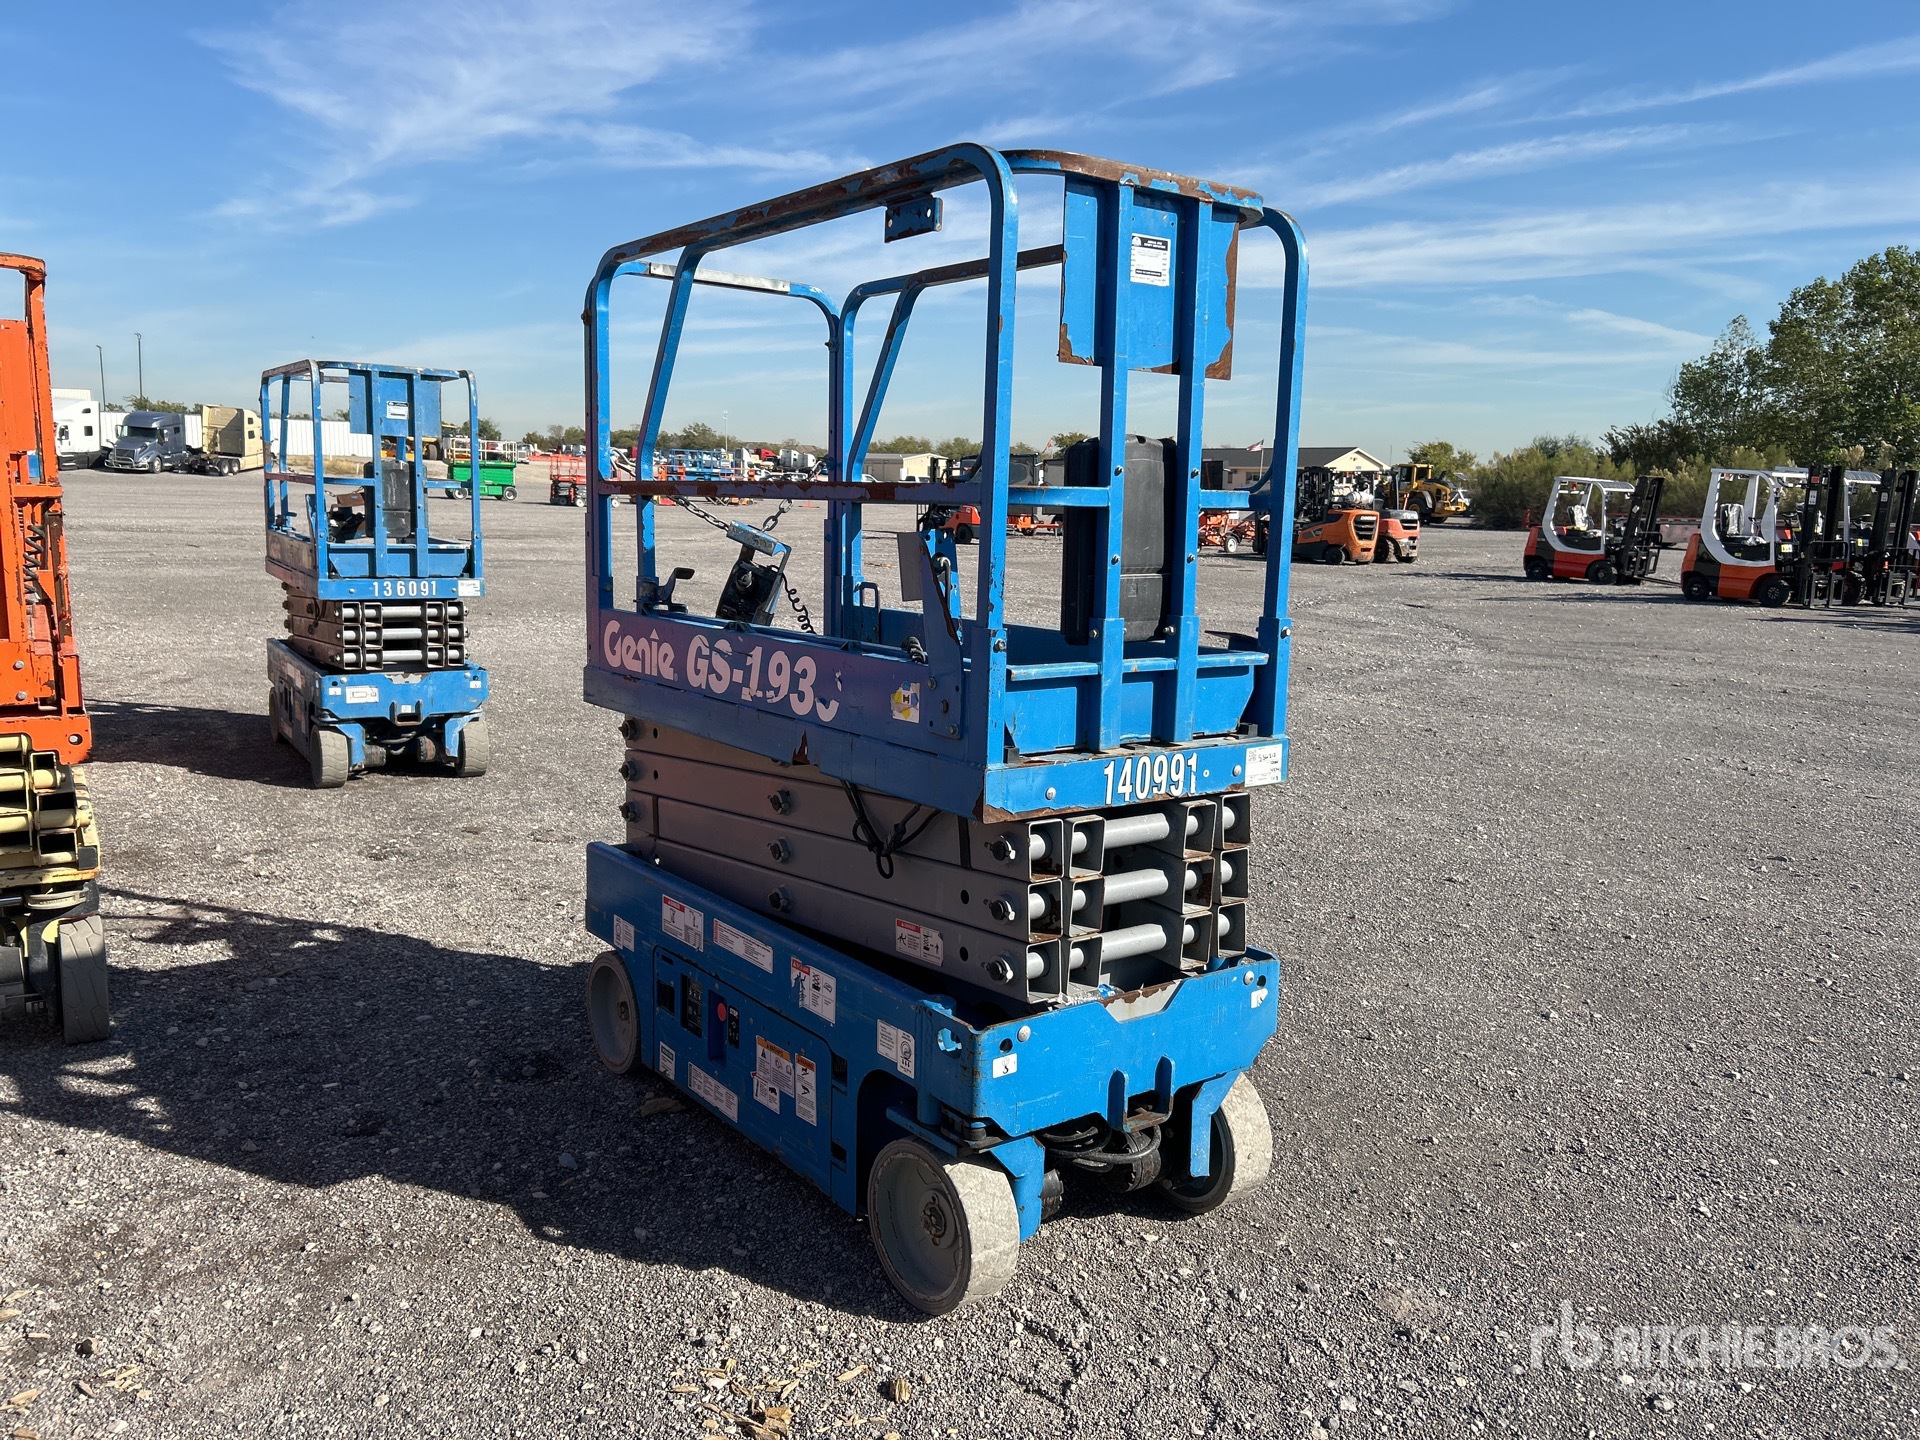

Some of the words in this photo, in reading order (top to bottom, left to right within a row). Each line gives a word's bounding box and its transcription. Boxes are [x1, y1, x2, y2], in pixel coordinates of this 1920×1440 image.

[372, 580, 437, 597] 136091
[603, 619, 676, 681] Genie
[1103, 752, 1198, 805] 140991
